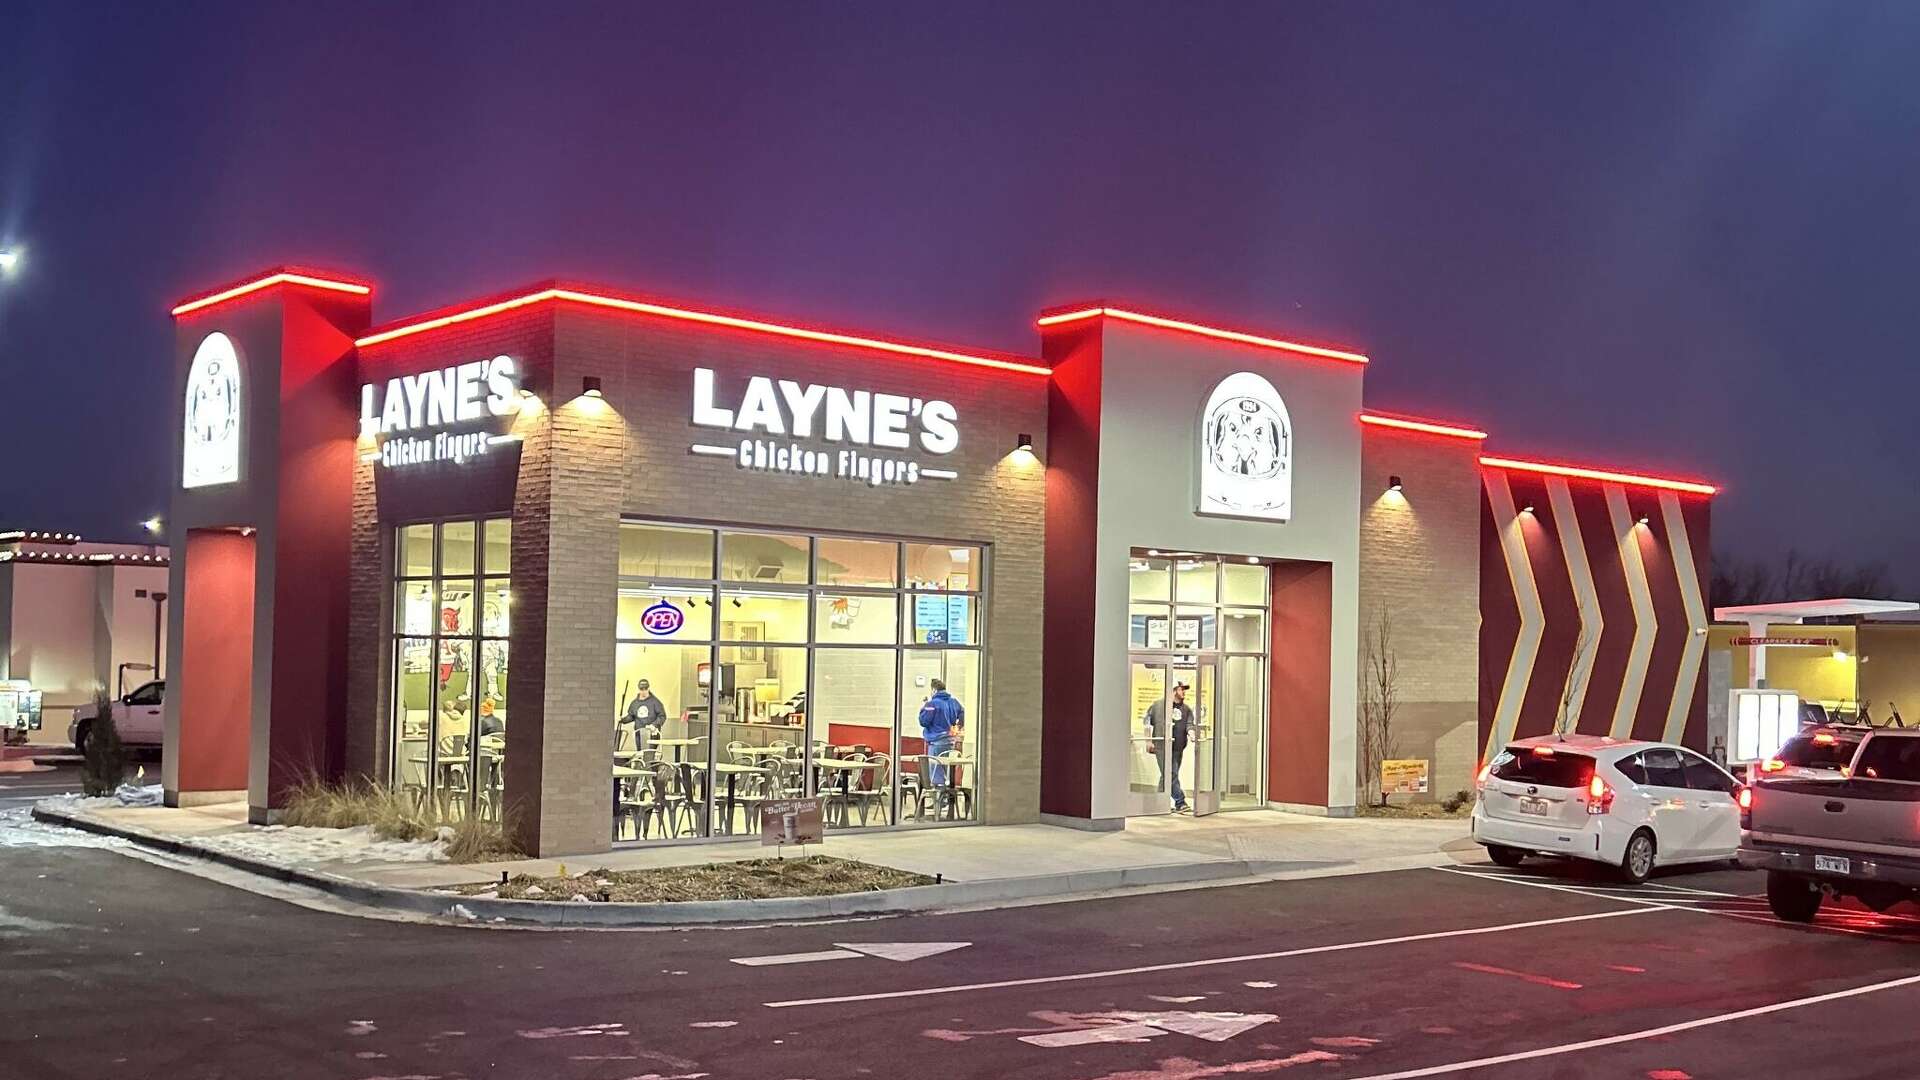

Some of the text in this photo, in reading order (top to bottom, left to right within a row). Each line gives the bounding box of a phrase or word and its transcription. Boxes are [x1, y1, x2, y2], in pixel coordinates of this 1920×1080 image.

[360, 355, 516, 433] LAYNE'S
[692, 367, 959, 454] LAYNE'S
[382, 431, 487, 467] Chicken Fingers
[739, 439, 919, 486] Chicken Fingers
[644, 612, 680, 628] OPEN
